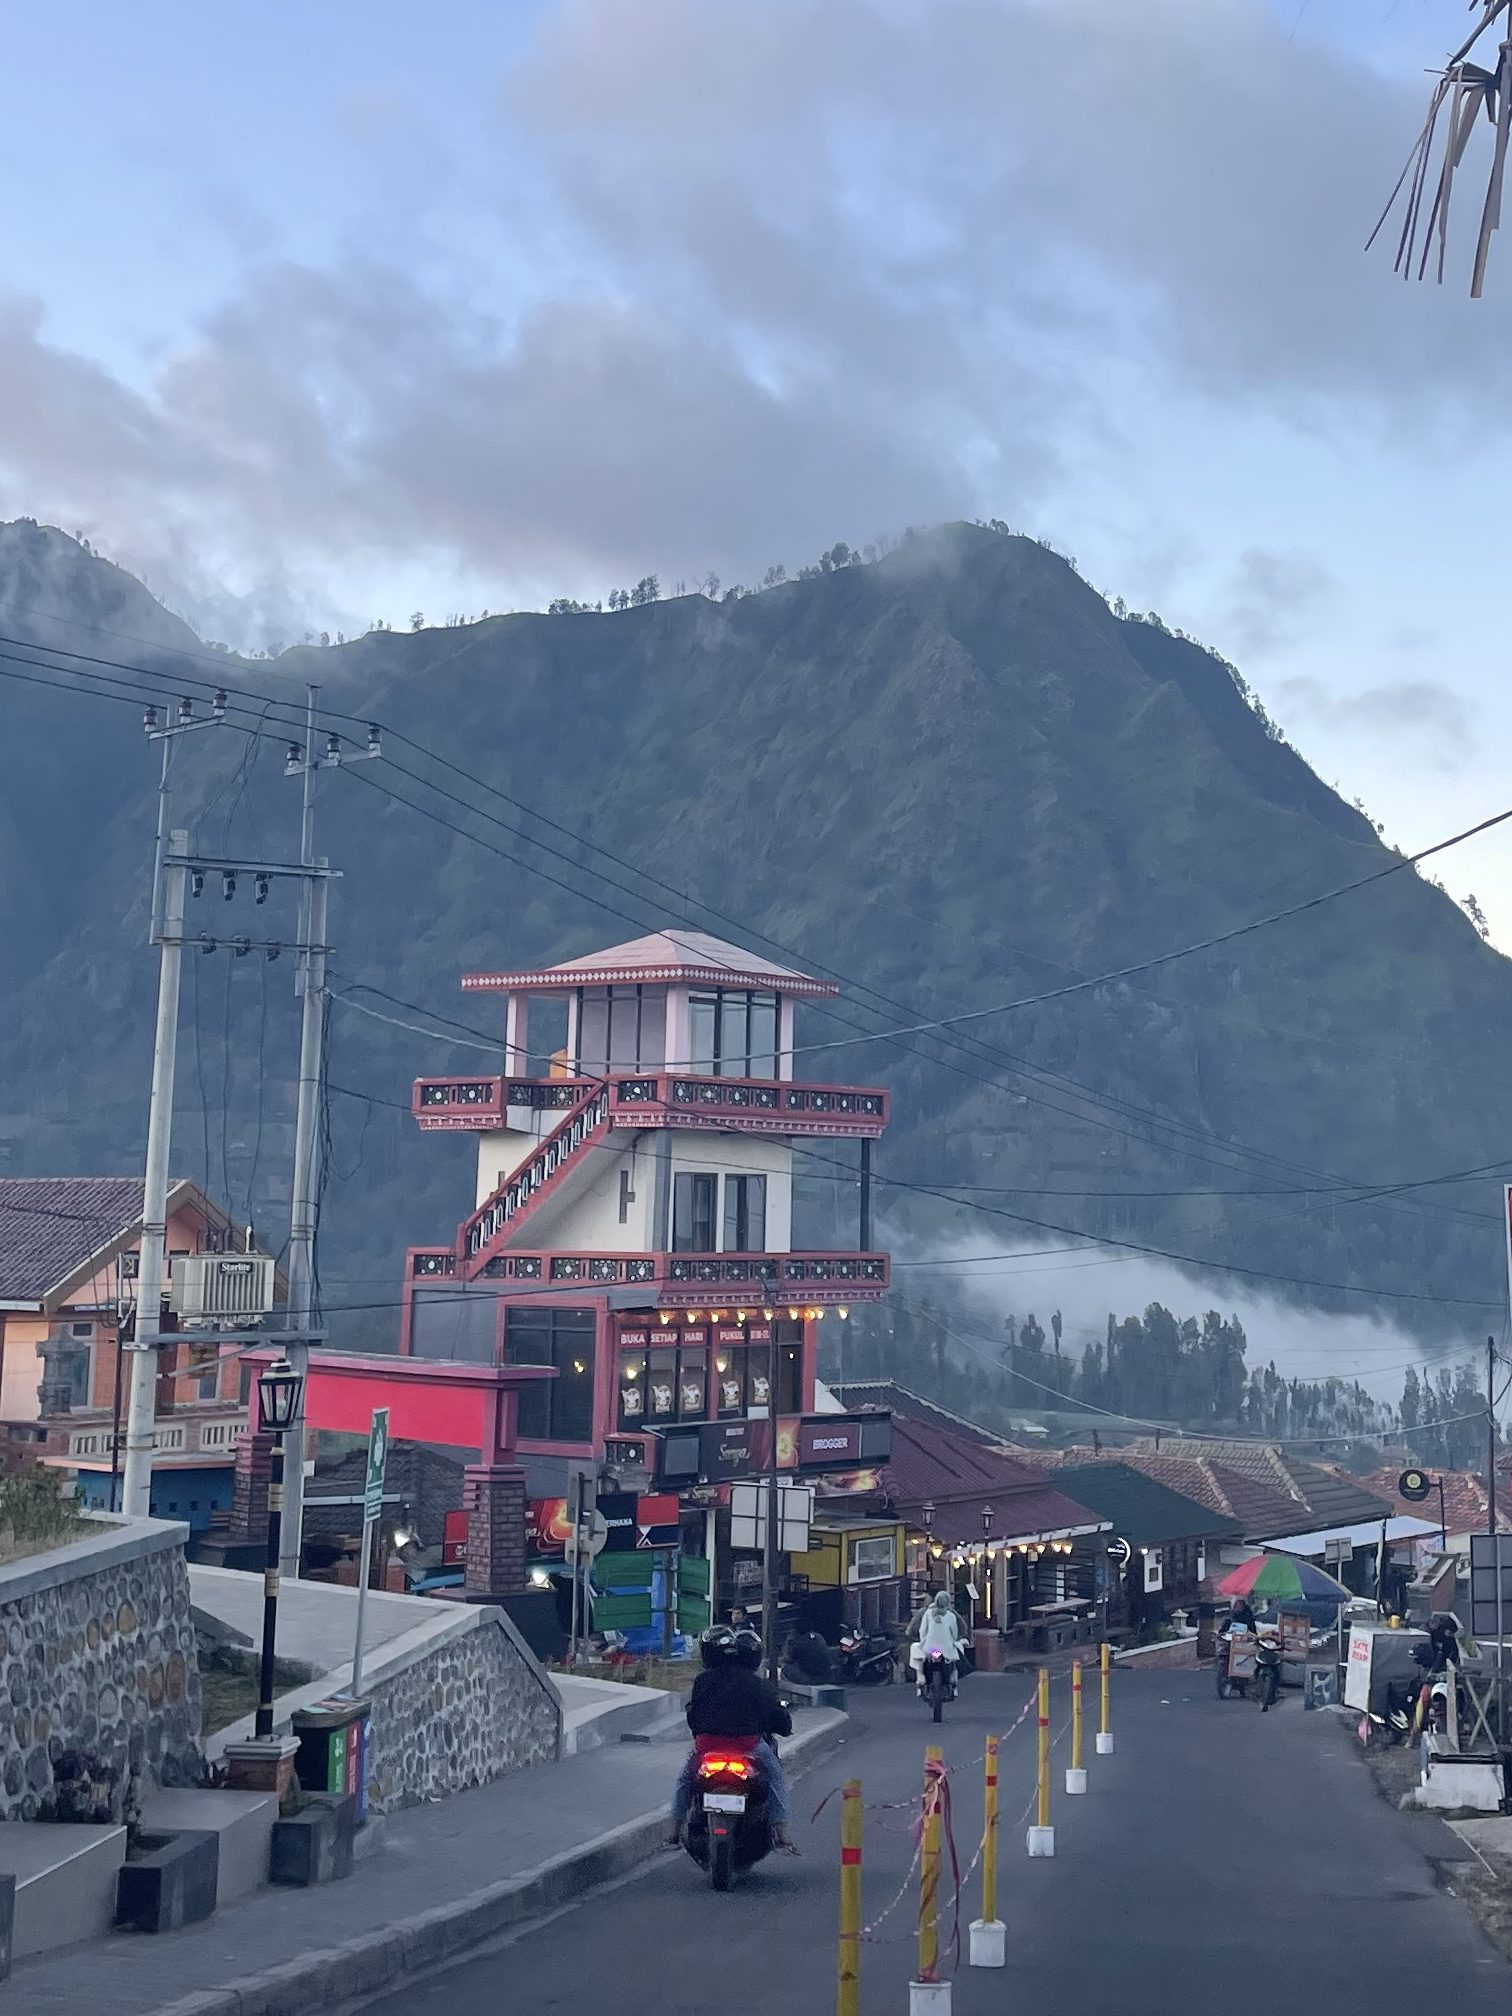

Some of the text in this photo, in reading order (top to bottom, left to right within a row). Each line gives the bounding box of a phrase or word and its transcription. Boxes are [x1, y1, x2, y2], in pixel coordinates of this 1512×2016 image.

[221, 1263, 250, 1272] Starlite
[621, 1334, 645, 1344] BUKA
[650, 1333, 677, 1343] SETIAP
[684, 1332, 703, 1341] HARI
[720, 1331, 744, 1341] PUKUL
